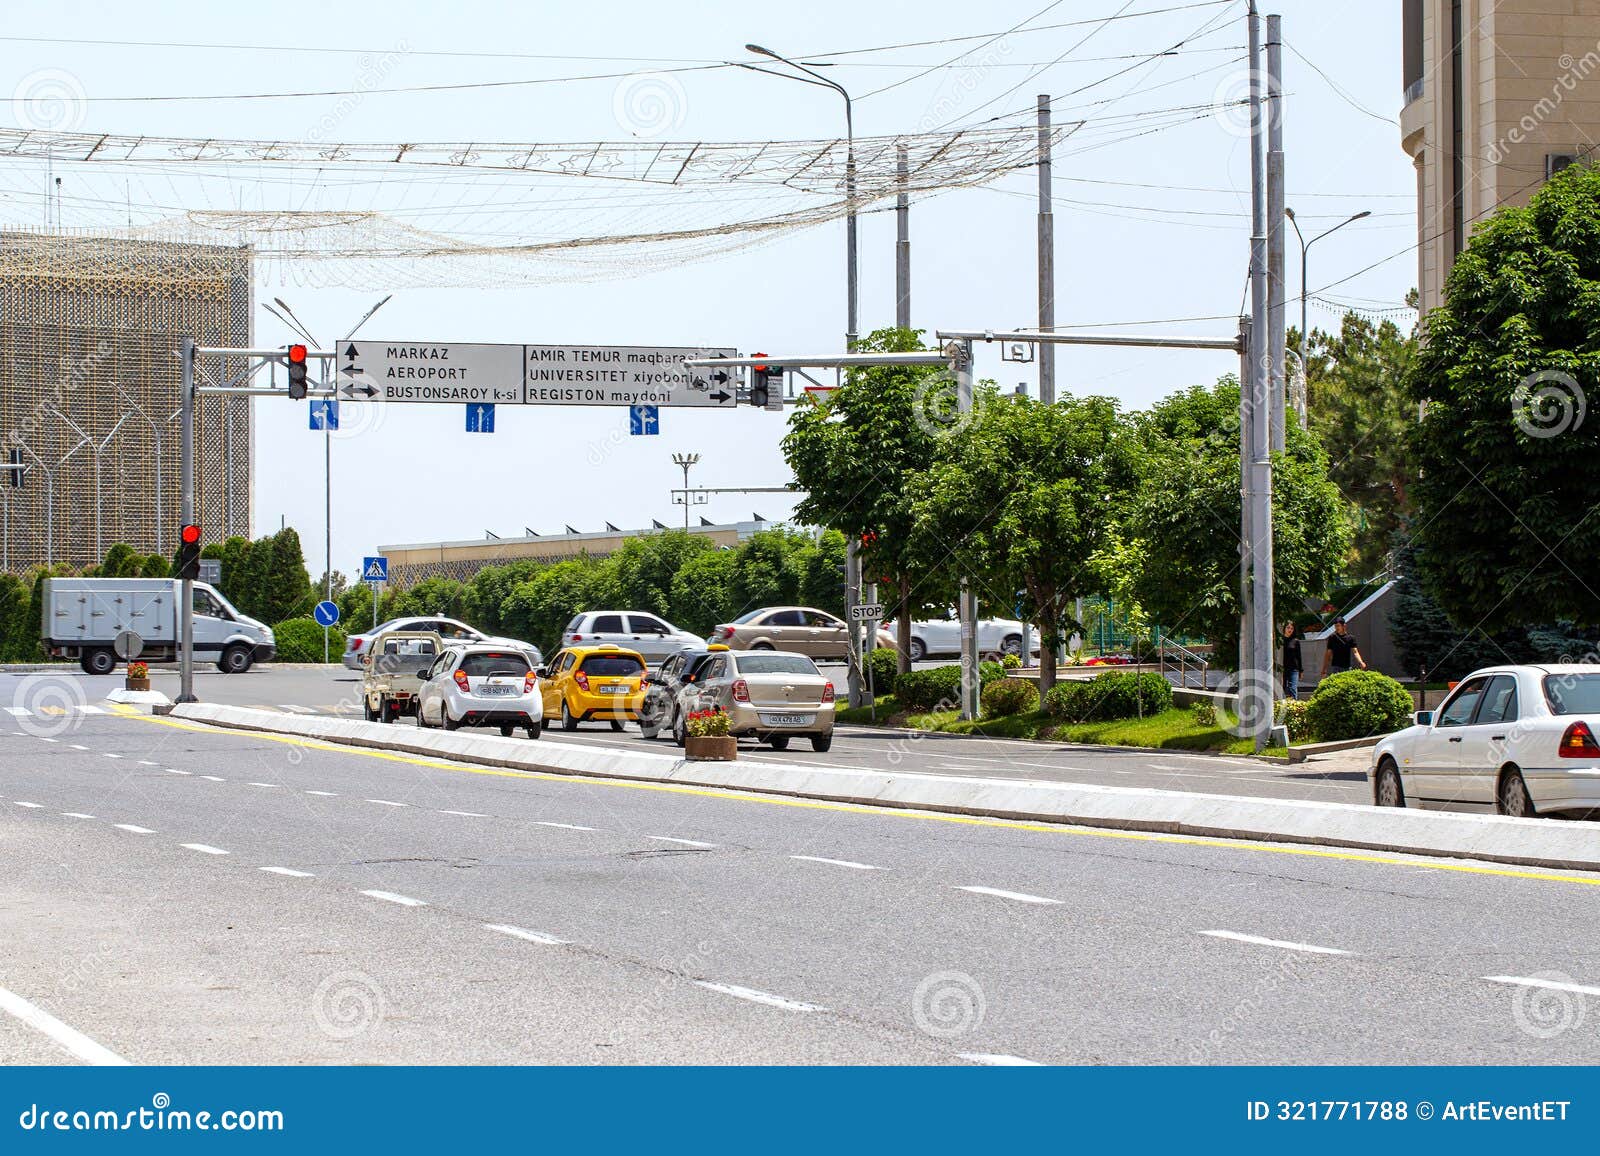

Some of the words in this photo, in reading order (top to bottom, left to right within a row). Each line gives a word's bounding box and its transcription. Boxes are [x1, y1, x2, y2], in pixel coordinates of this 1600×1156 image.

[386, 347, 449, 360] MARKAZ
[530, 349, 566, 361] AMIR
[572, 350, 621, 362] TEMUR
[386, 366, 467, 379] AEROPORT
[530, 369, 628, 382] UNIVERSITET
[634, 370, 694, 385] xiyoboni
[386, 386, 488, 400] BUSTONSAROY
[493, 388, 517, 400] k-si
[529, 388, 605, 401] REGISTON
[611, 390, 671, 404] maydoni
[852, 606, 882, 618] STOP
